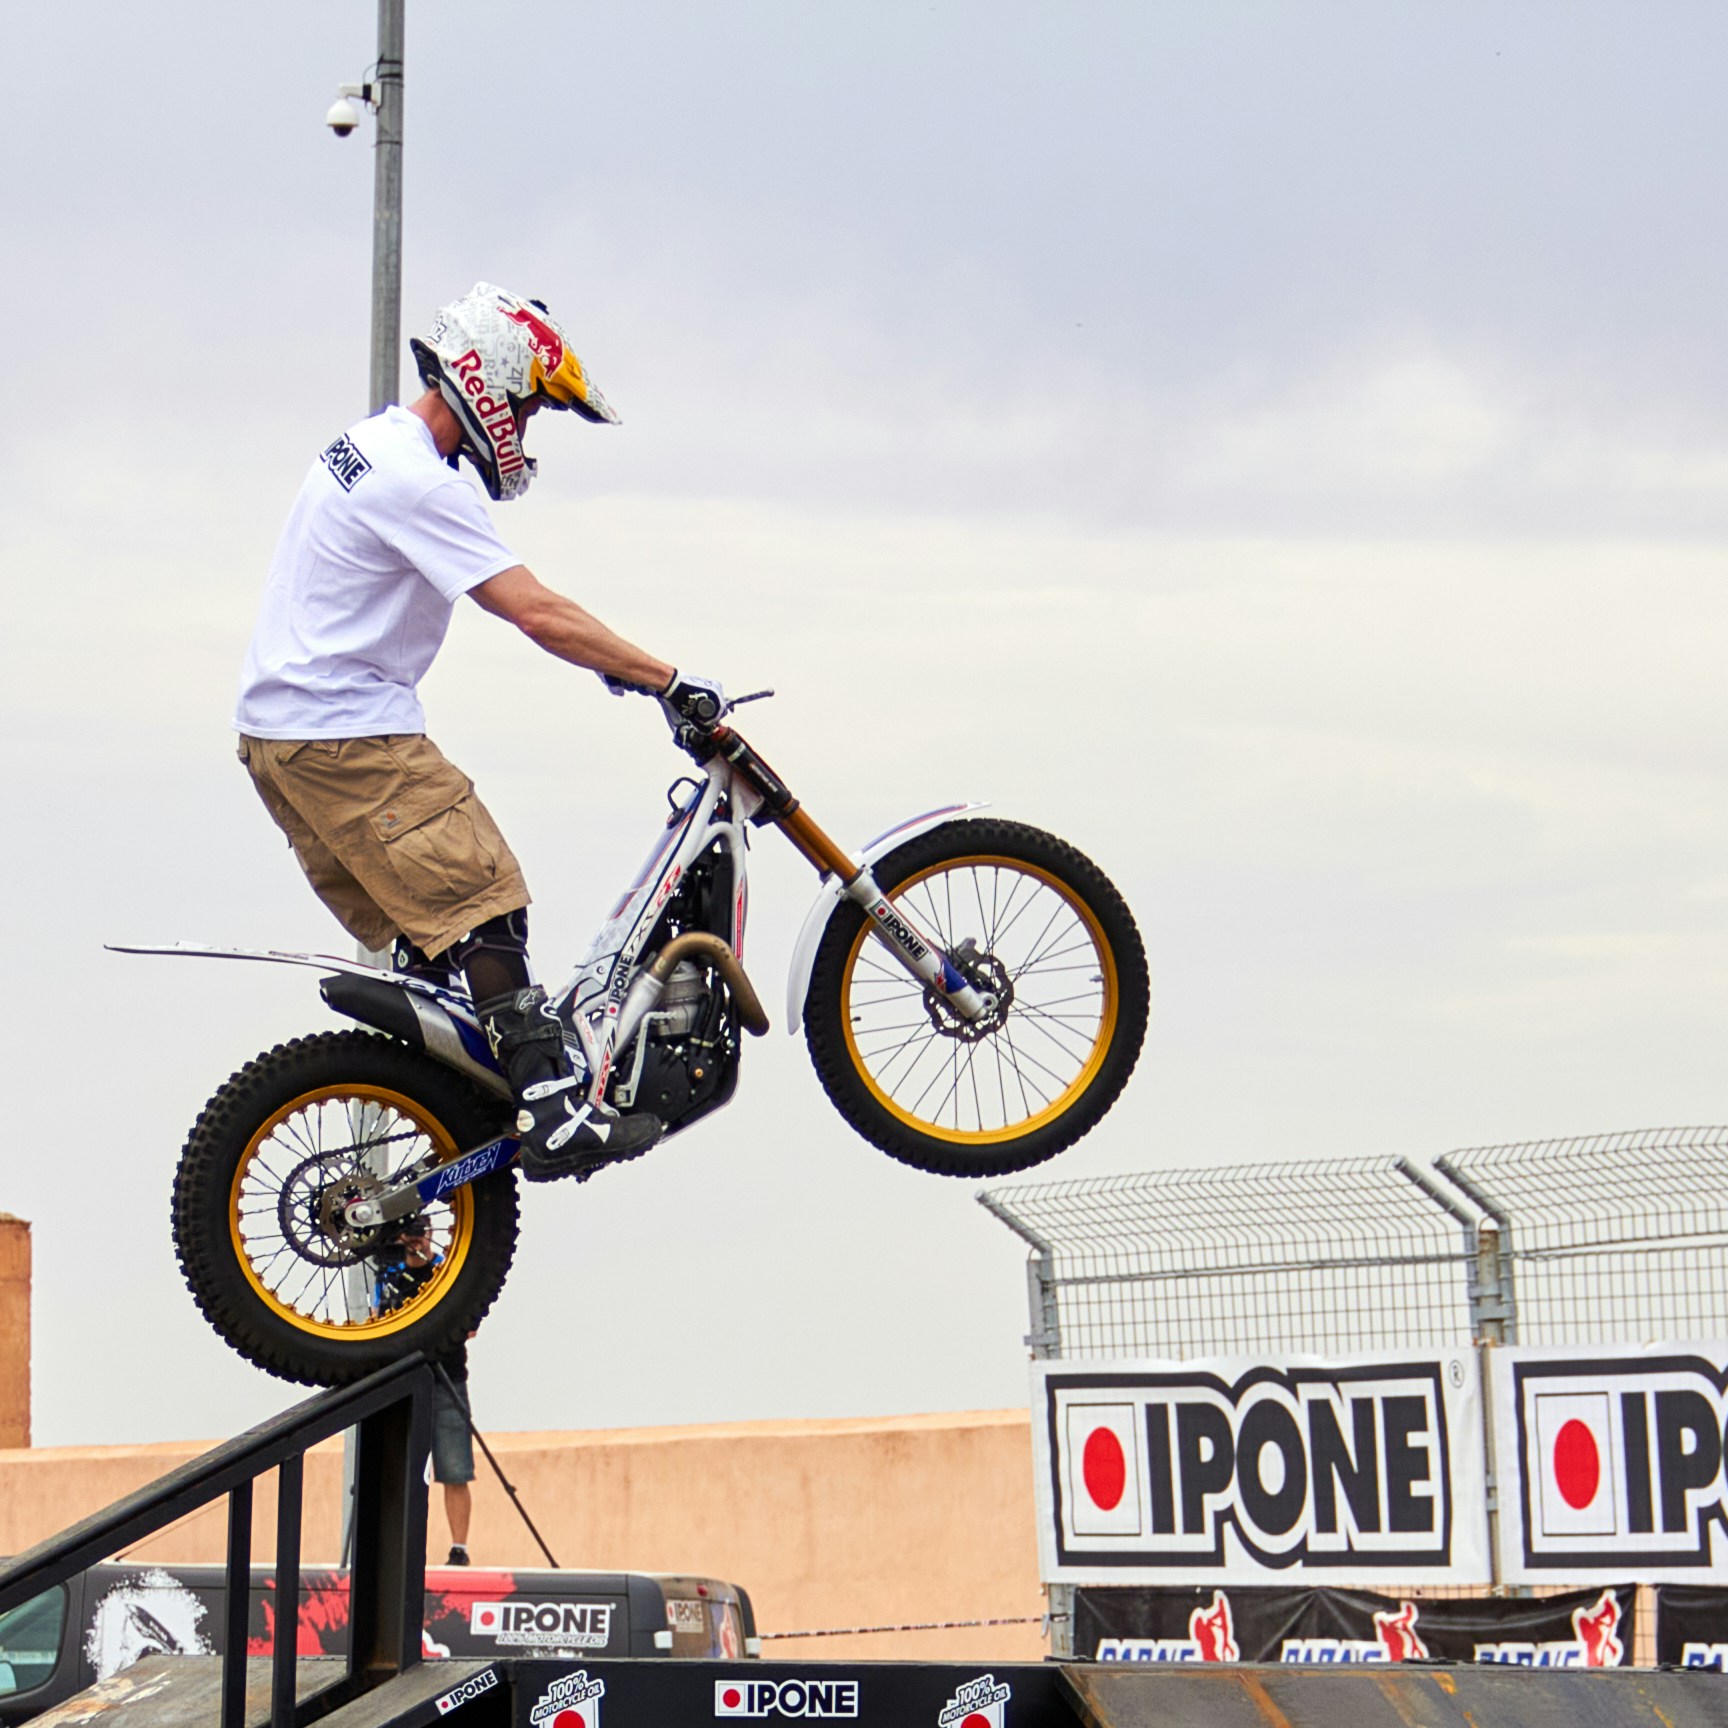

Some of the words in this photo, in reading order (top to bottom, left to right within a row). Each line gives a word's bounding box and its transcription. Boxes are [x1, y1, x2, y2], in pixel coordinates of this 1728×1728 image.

[451, 348, 510, 418] Red
[487, 415, 525, 475] Bull
[883, 914, 925, 958] IPONE
[608, 955, 633, 1004] IPONE
[1145, 1395, 1436, 1536] IPONE
[501, 1606, 607, 1634] IPONE
[448, 1671, 499, 1706] IPONE
[534, 1690, 586, 1720] MOTORCYCLE
[587, 1683, 601, 1697] OIL
[552, 1675, 584, 1701] 100%
[747, 1682, 855, 1715] IPONE
[942, 1694, 993, 1723] MOTORCYCLE
[993, 1688, 1007, 1701] OIL
[959, 1678, 990, 1705] 100%
